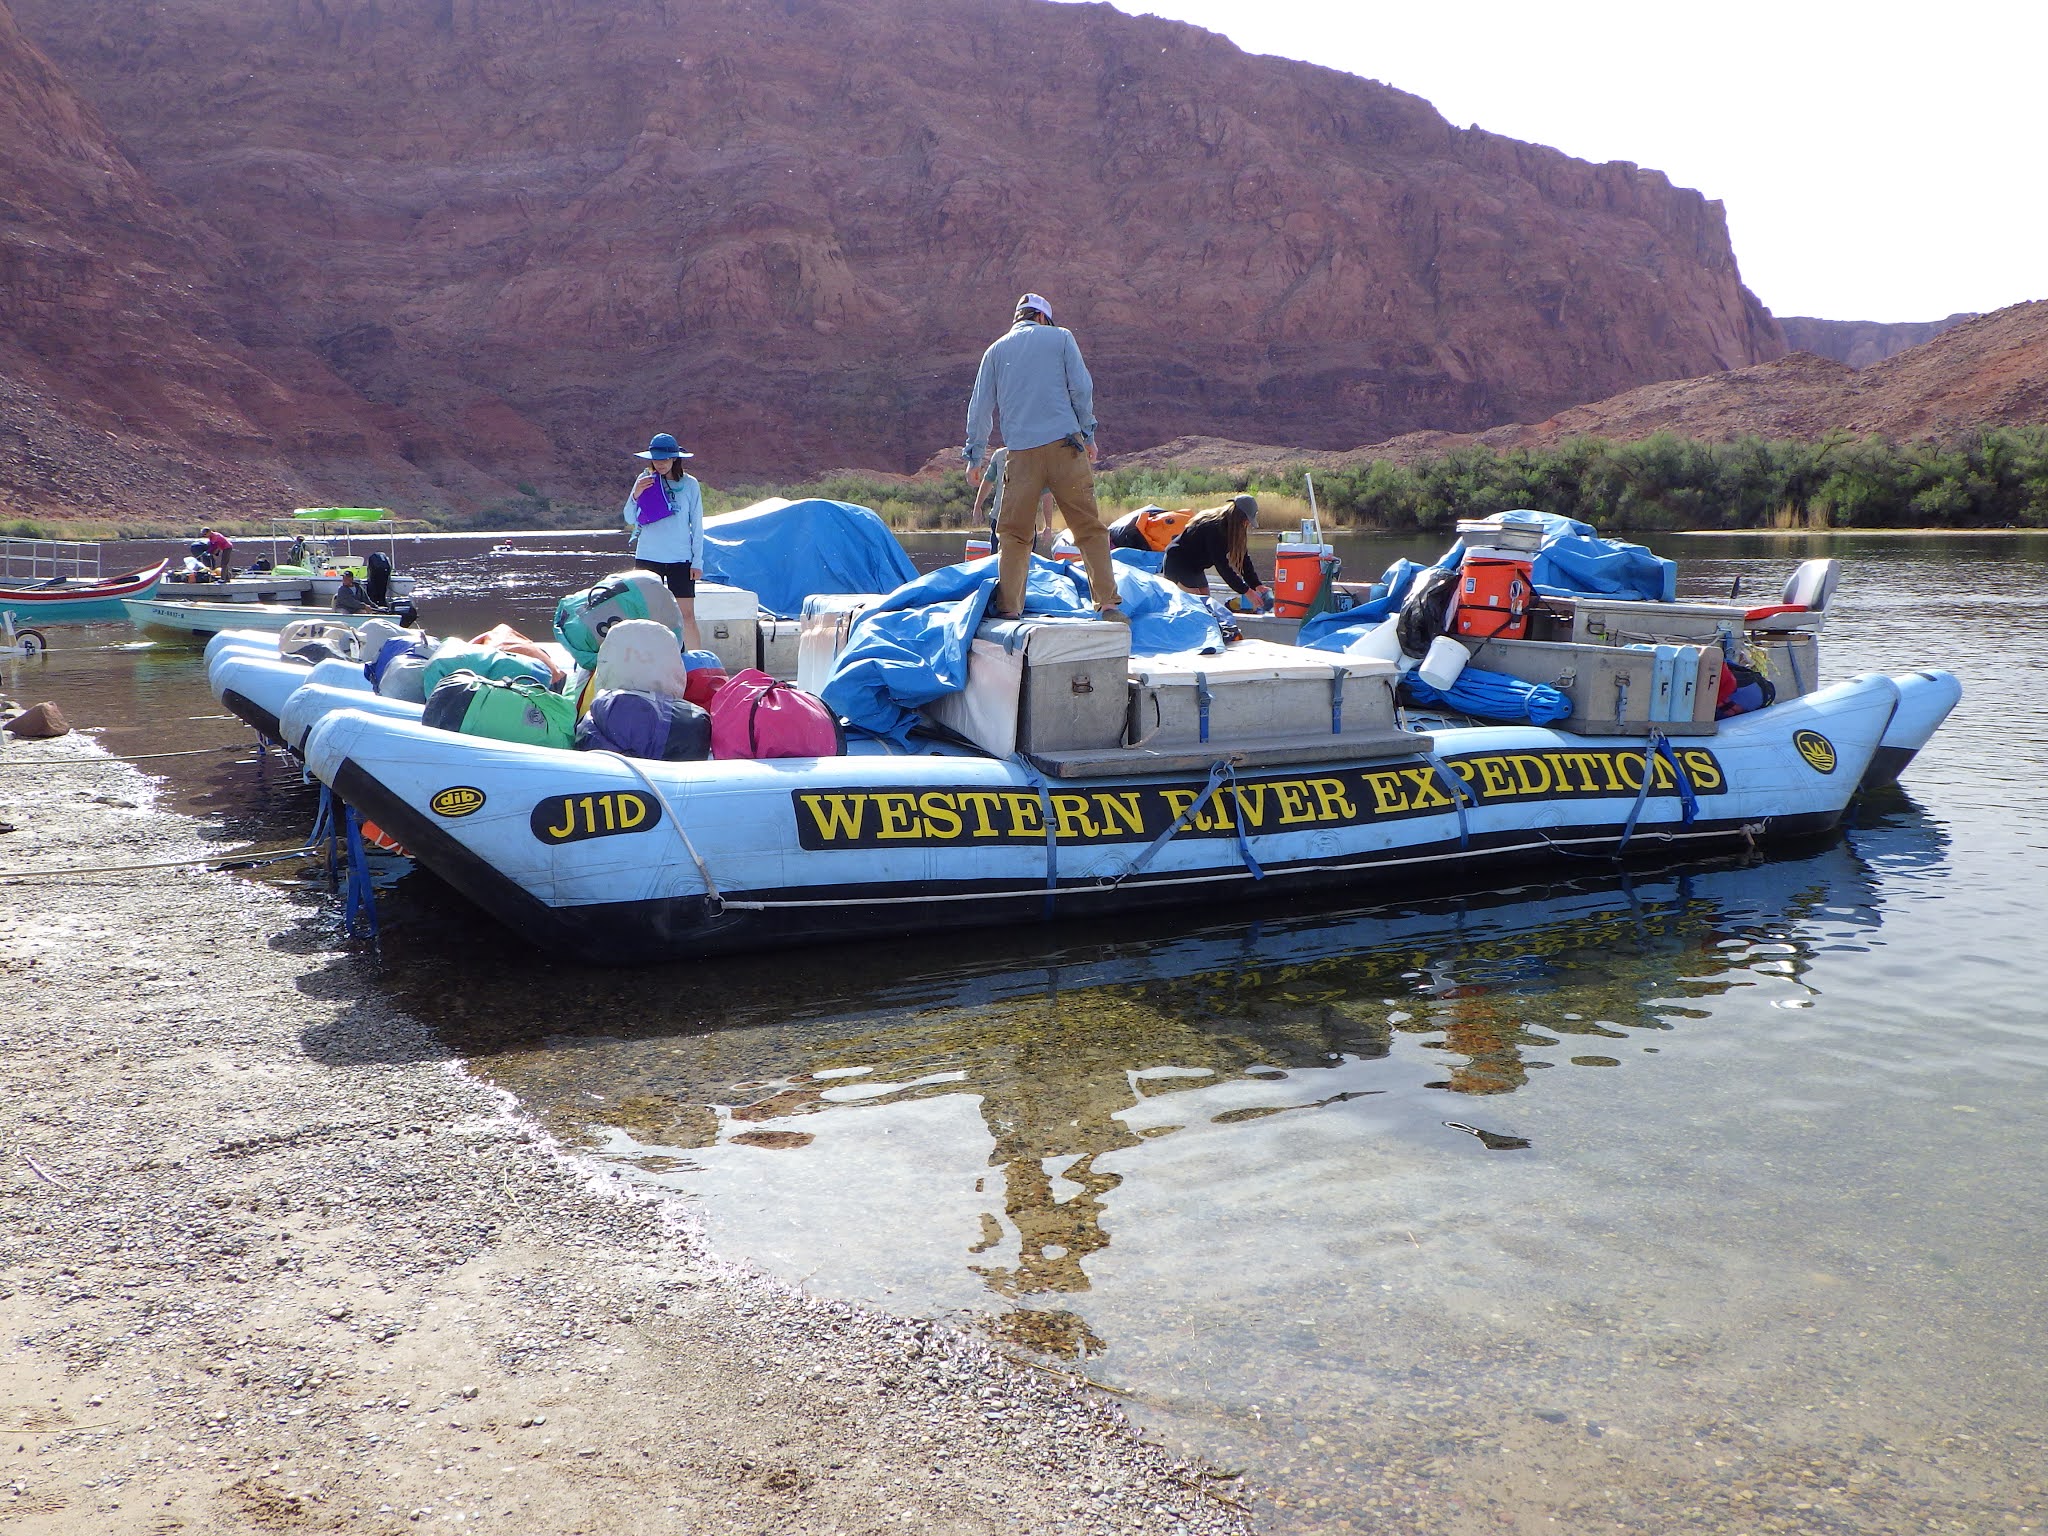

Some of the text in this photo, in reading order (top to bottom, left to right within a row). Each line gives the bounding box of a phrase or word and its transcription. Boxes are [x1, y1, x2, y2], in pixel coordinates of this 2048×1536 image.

[1661, 681, 1669, 696] F
[1685, 681, 1693, 696] F
[1707, 674, 1717, 691] F
[440, 791, 475, 806] dib
[800, 751, 1721, 841] WESTERN RIVER EXPEDITIONS
[548, 793, 646, 838] J11D
